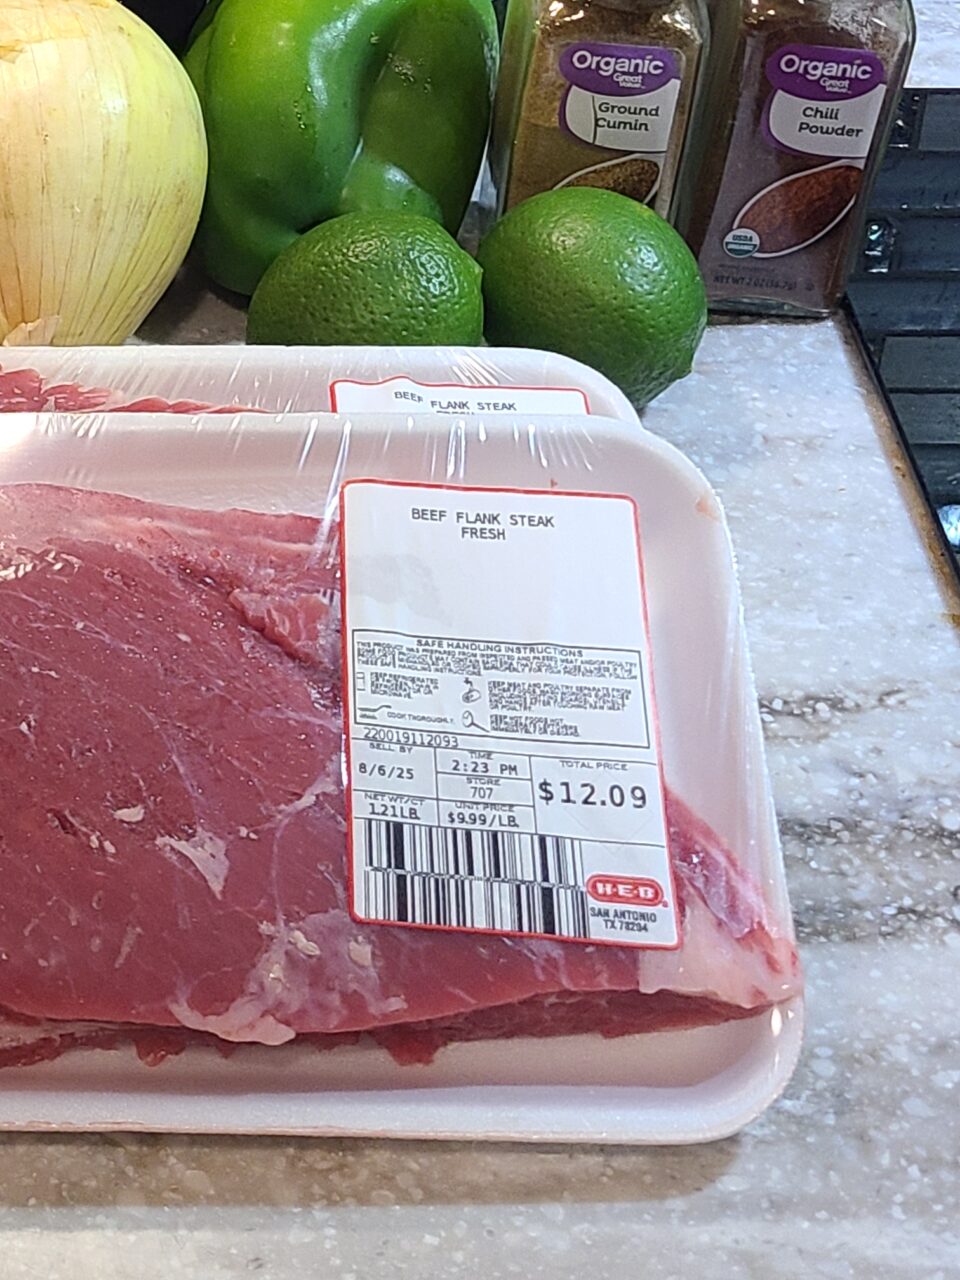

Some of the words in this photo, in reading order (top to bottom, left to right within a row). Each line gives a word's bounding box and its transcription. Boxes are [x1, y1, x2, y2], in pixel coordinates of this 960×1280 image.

[572, 50, 665, 76] Organic
[780, 54, 873, 80] Organic
[613, 73, 643, 83] Great
[820, 78, 850, 88] Great
[598, 102, 660, 117] Ground
[802, 106, 840, 121] Chili
[595, 117, 649, 132] Cumin
[798, 122, 864, 138] Powder
[394, 391, 424, 403] BEEF
[431, 400, 470, 410] FLANK
[477, 402, 518, 412] STEAK
[411, 507, 448, 522] BEEF
[456, 511, 500, 526] FLANK
[509, 514, 555, 528] STEAK
[461, 527, 506, 540] FRESH
[416, 639, 444, 649] SAFE
[447, 641, 502, 652] HANDLING
[505, 645, 583, 658] INSTRUCTIONS
[363, 727, 459, 748] 220019112093
[369, 742, 395, 752] SELL
[399, 746, 413, 754] BY
[469, 751, 493, 760] TIME
[358, 762, 414, 780] 8/6/25
[452, 760, 489, 773] 2:23
[500, 764, 518, 776] PM
[559, 759, 594, 769] TOTAL
[596, 762, 629, 771] PRICE
[466, 777, 501, 786] STORE
[364, 792, 387, 802] NET
[470, 786, 494, 799] 707
[538, 778, 647, 809] $12.09
[455, 802, 480, 811] UNIT
[484, 804, 516, 813] PRICE
[589, 906, 611, 918] SAN
[612, 907, 657, 923] ANTONIO
[602, 919, 618, 930] TX
